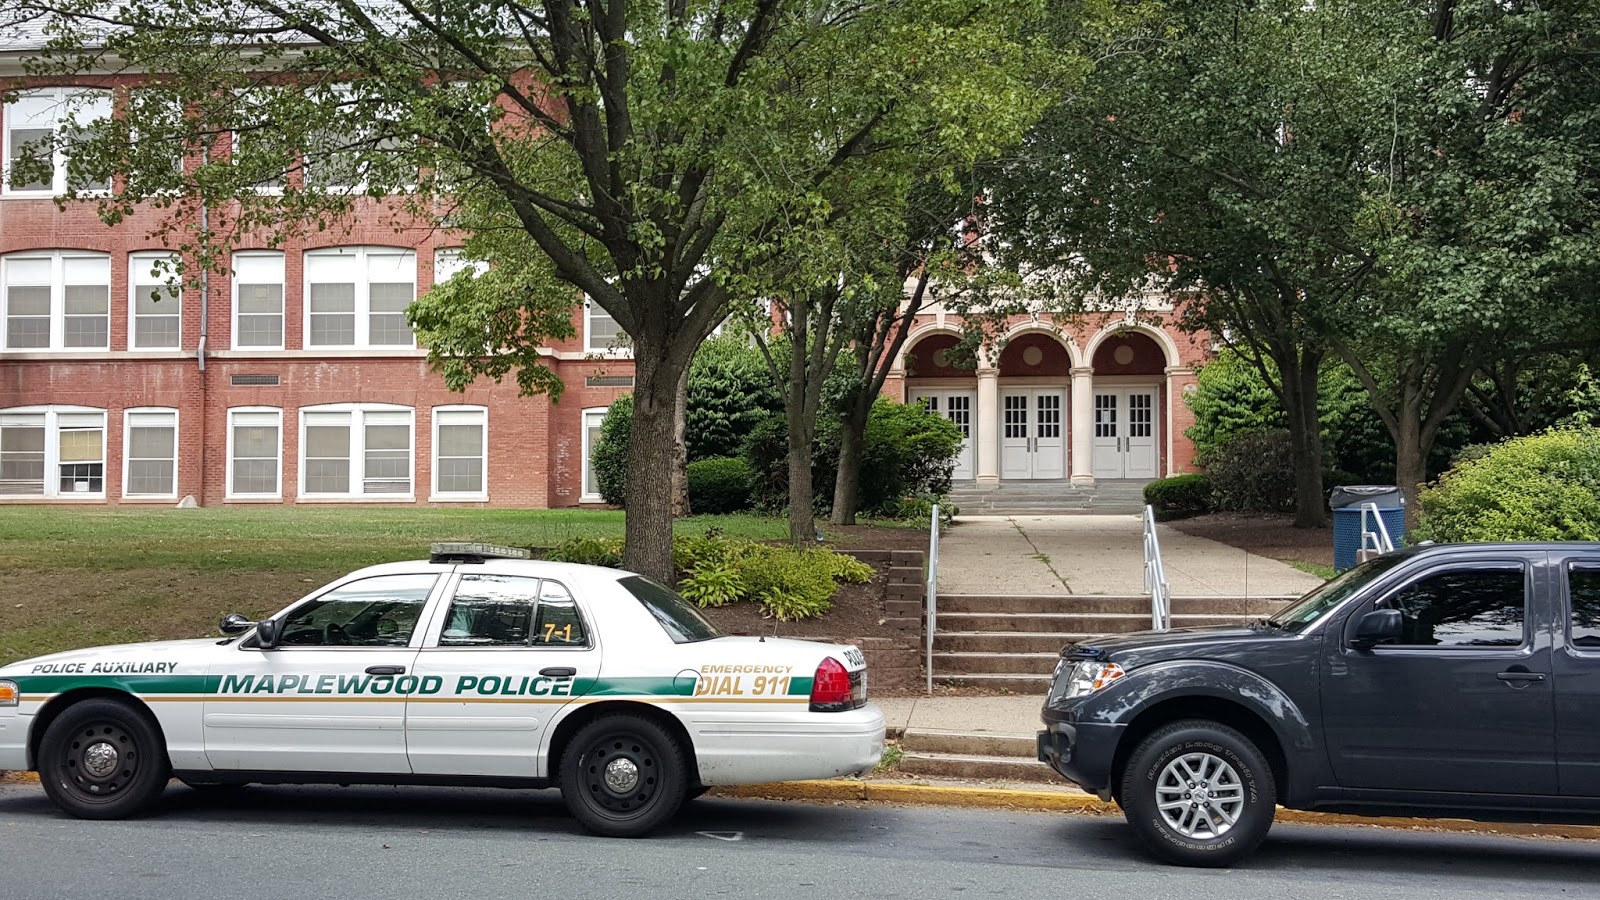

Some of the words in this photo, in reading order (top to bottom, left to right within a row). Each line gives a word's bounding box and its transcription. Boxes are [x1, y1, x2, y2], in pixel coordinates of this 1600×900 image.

[545, 624, 571, 642] 7-1
[31, 662, 86, 674] POLICE
[90, 661, 178, 674] AUXILIARY
[701, 665, 793, 674] EMERGENCY
[221, 674, 442, 695] MAPLEWOOD
[455, 676, 574, 696] POLICE
[696, 676, 743, 696] DIAL
[752, 676, 789, 696] 911
